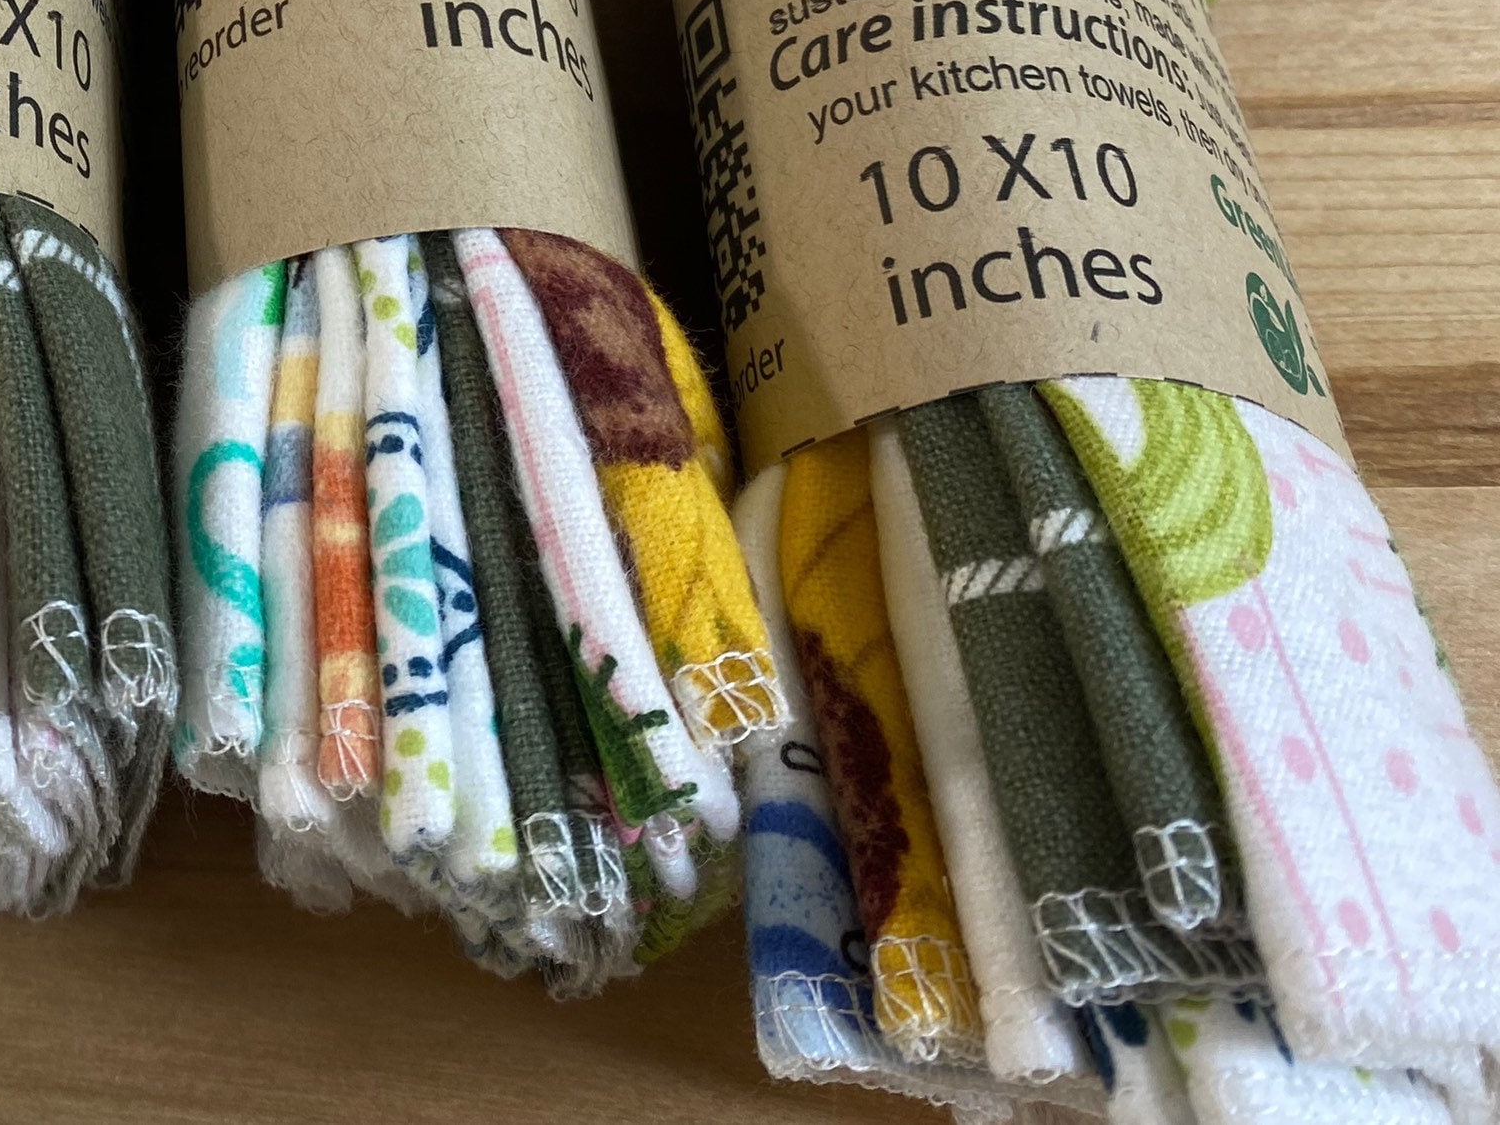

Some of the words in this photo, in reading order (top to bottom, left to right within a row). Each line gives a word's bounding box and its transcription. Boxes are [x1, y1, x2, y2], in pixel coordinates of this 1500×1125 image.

[769, 12, 894, 92] Care
[808, 75, 899, 143] your
[911, 54, 1072, 104] kitchen
[1078, 64, 1181, 138] towels,
[1179, 107, 1224, 166] then
[858, 144, 961, 226] 10
[980, 132, 1140, 209] X10
[880, 225, 1165, 327] inches
